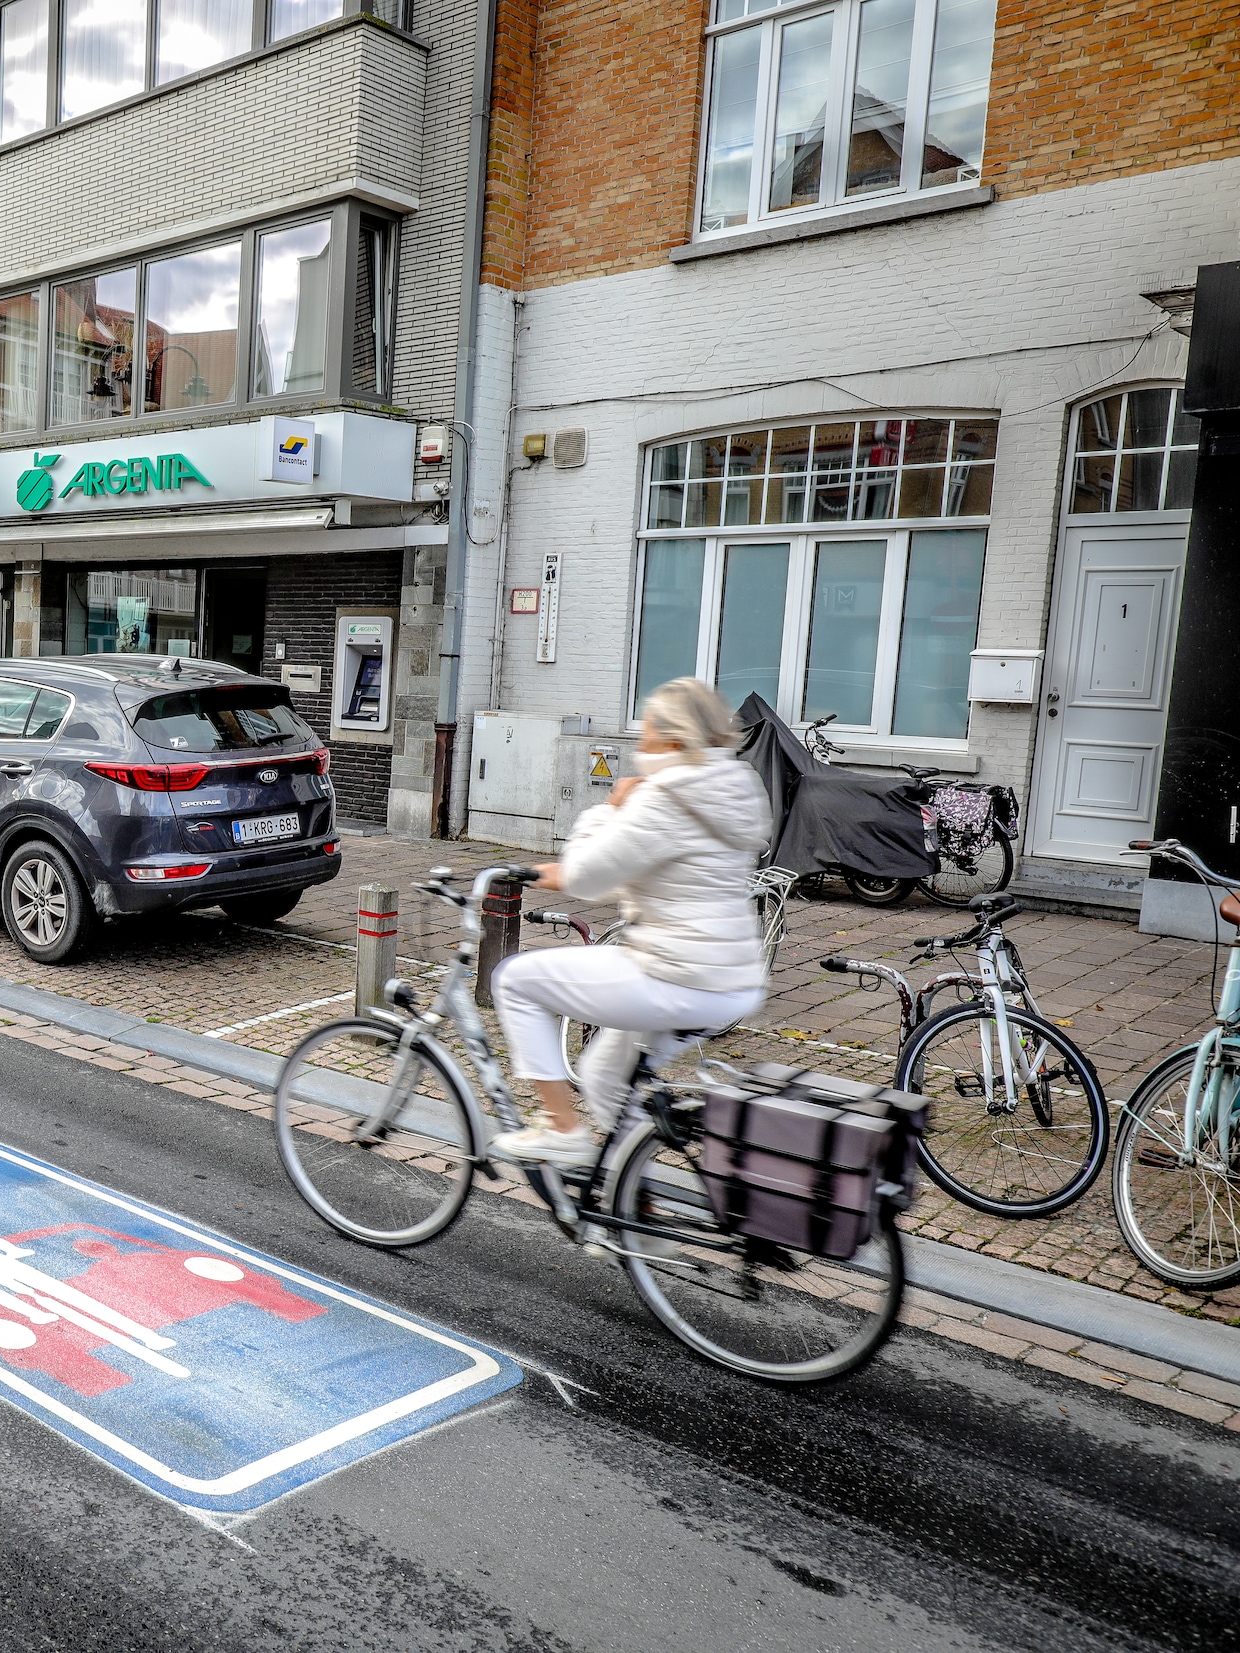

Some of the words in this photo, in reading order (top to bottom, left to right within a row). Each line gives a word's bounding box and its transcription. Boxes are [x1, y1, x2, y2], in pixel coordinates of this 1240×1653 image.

[278, 455, 308, 466] Bancontact
[57, 453, 213, 498] ARGENTA
[1121, 603, 1128, 618] 1
[1016, 680, 1022, 689] 1
[263, 773, 278, 781] KIA
[181, 799, 221, 808] SPORTAGE
